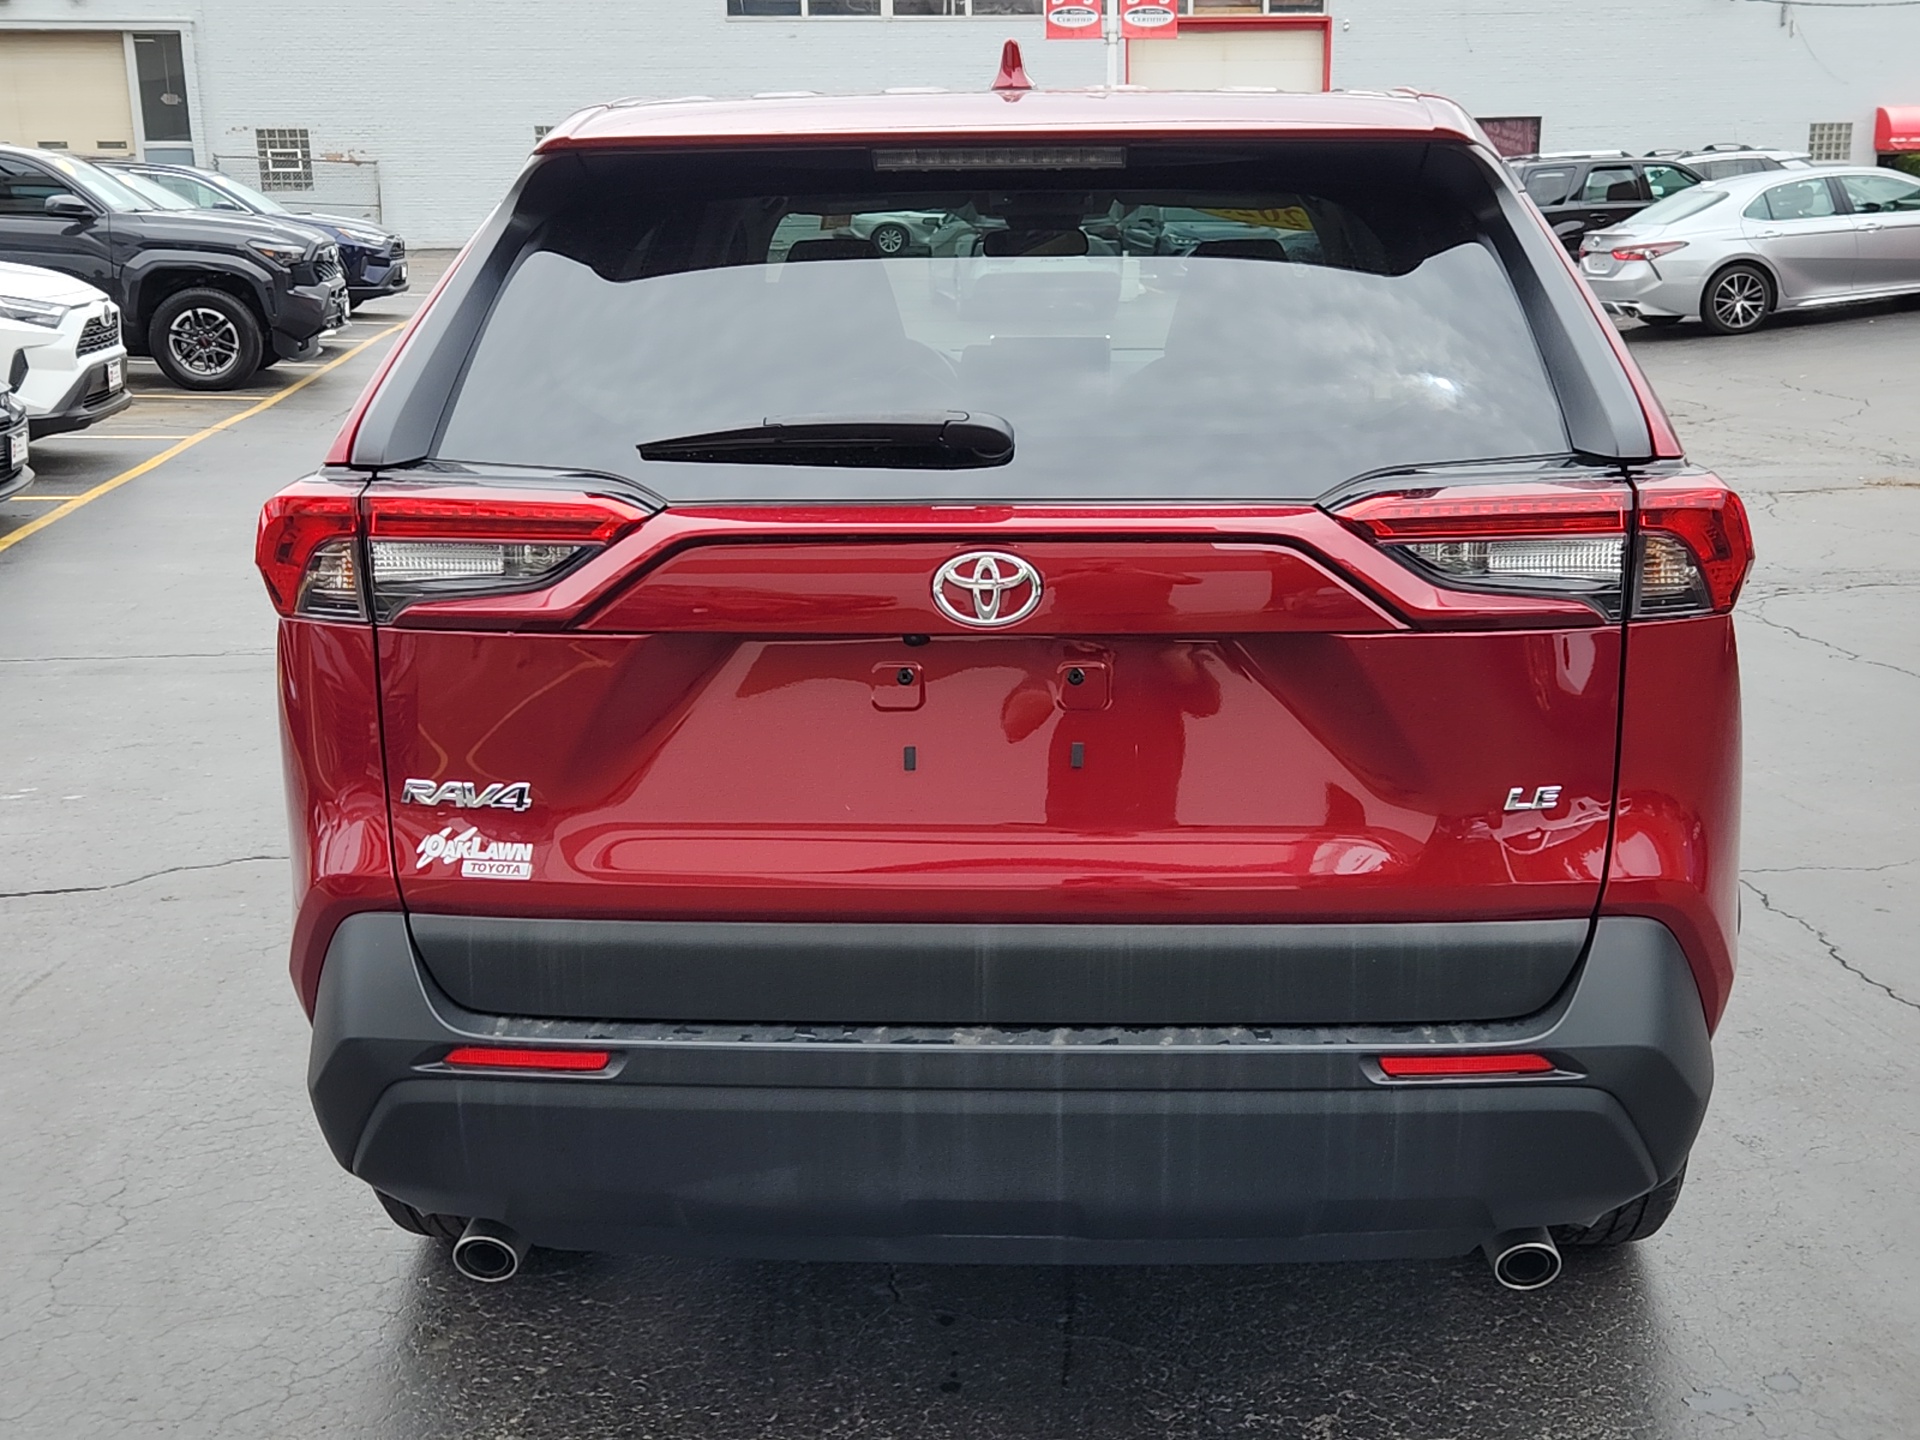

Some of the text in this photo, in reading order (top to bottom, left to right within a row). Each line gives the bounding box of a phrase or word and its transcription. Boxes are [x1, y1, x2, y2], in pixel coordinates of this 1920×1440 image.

[401, 778, 533, 812] RAV4
[1503, 785, 1563, 811] LE
[470, 862, 521, 875] TOYOTA
